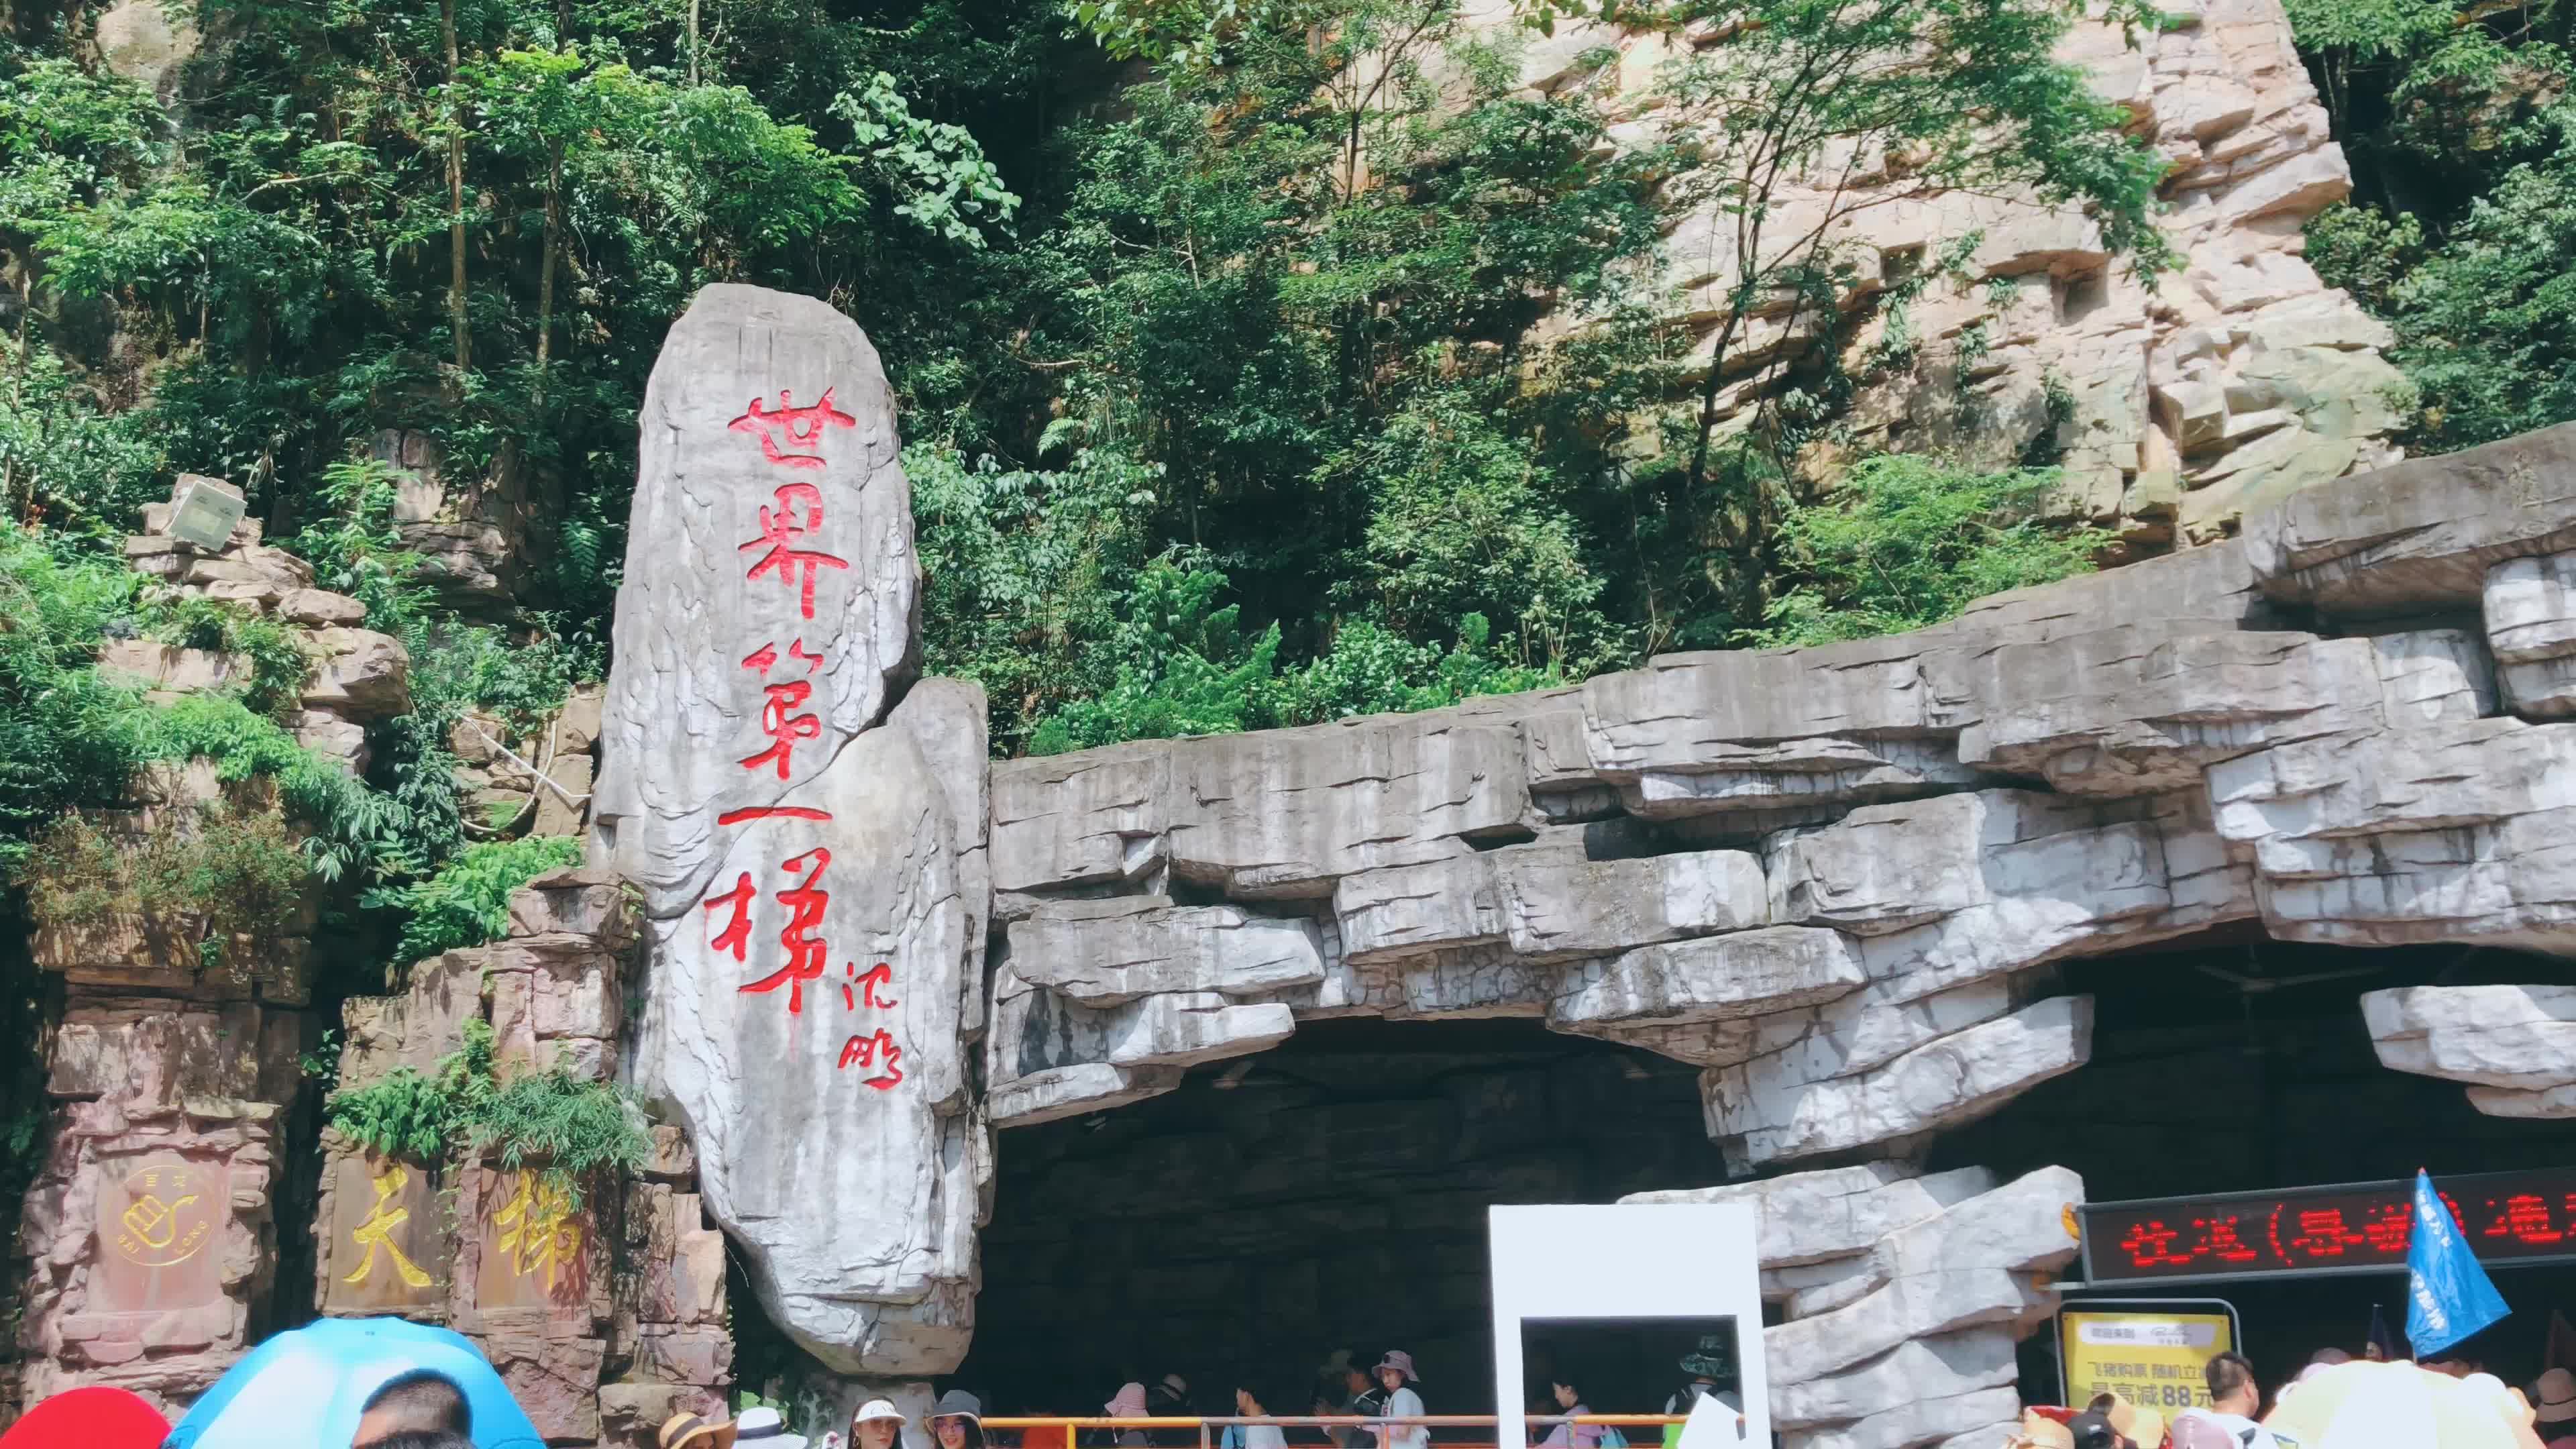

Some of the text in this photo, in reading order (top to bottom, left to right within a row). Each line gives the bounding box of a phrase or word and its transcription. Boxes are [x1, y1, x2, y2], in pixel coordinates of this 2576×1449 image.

[702, 385, 857, 1014] 世界第一梯
